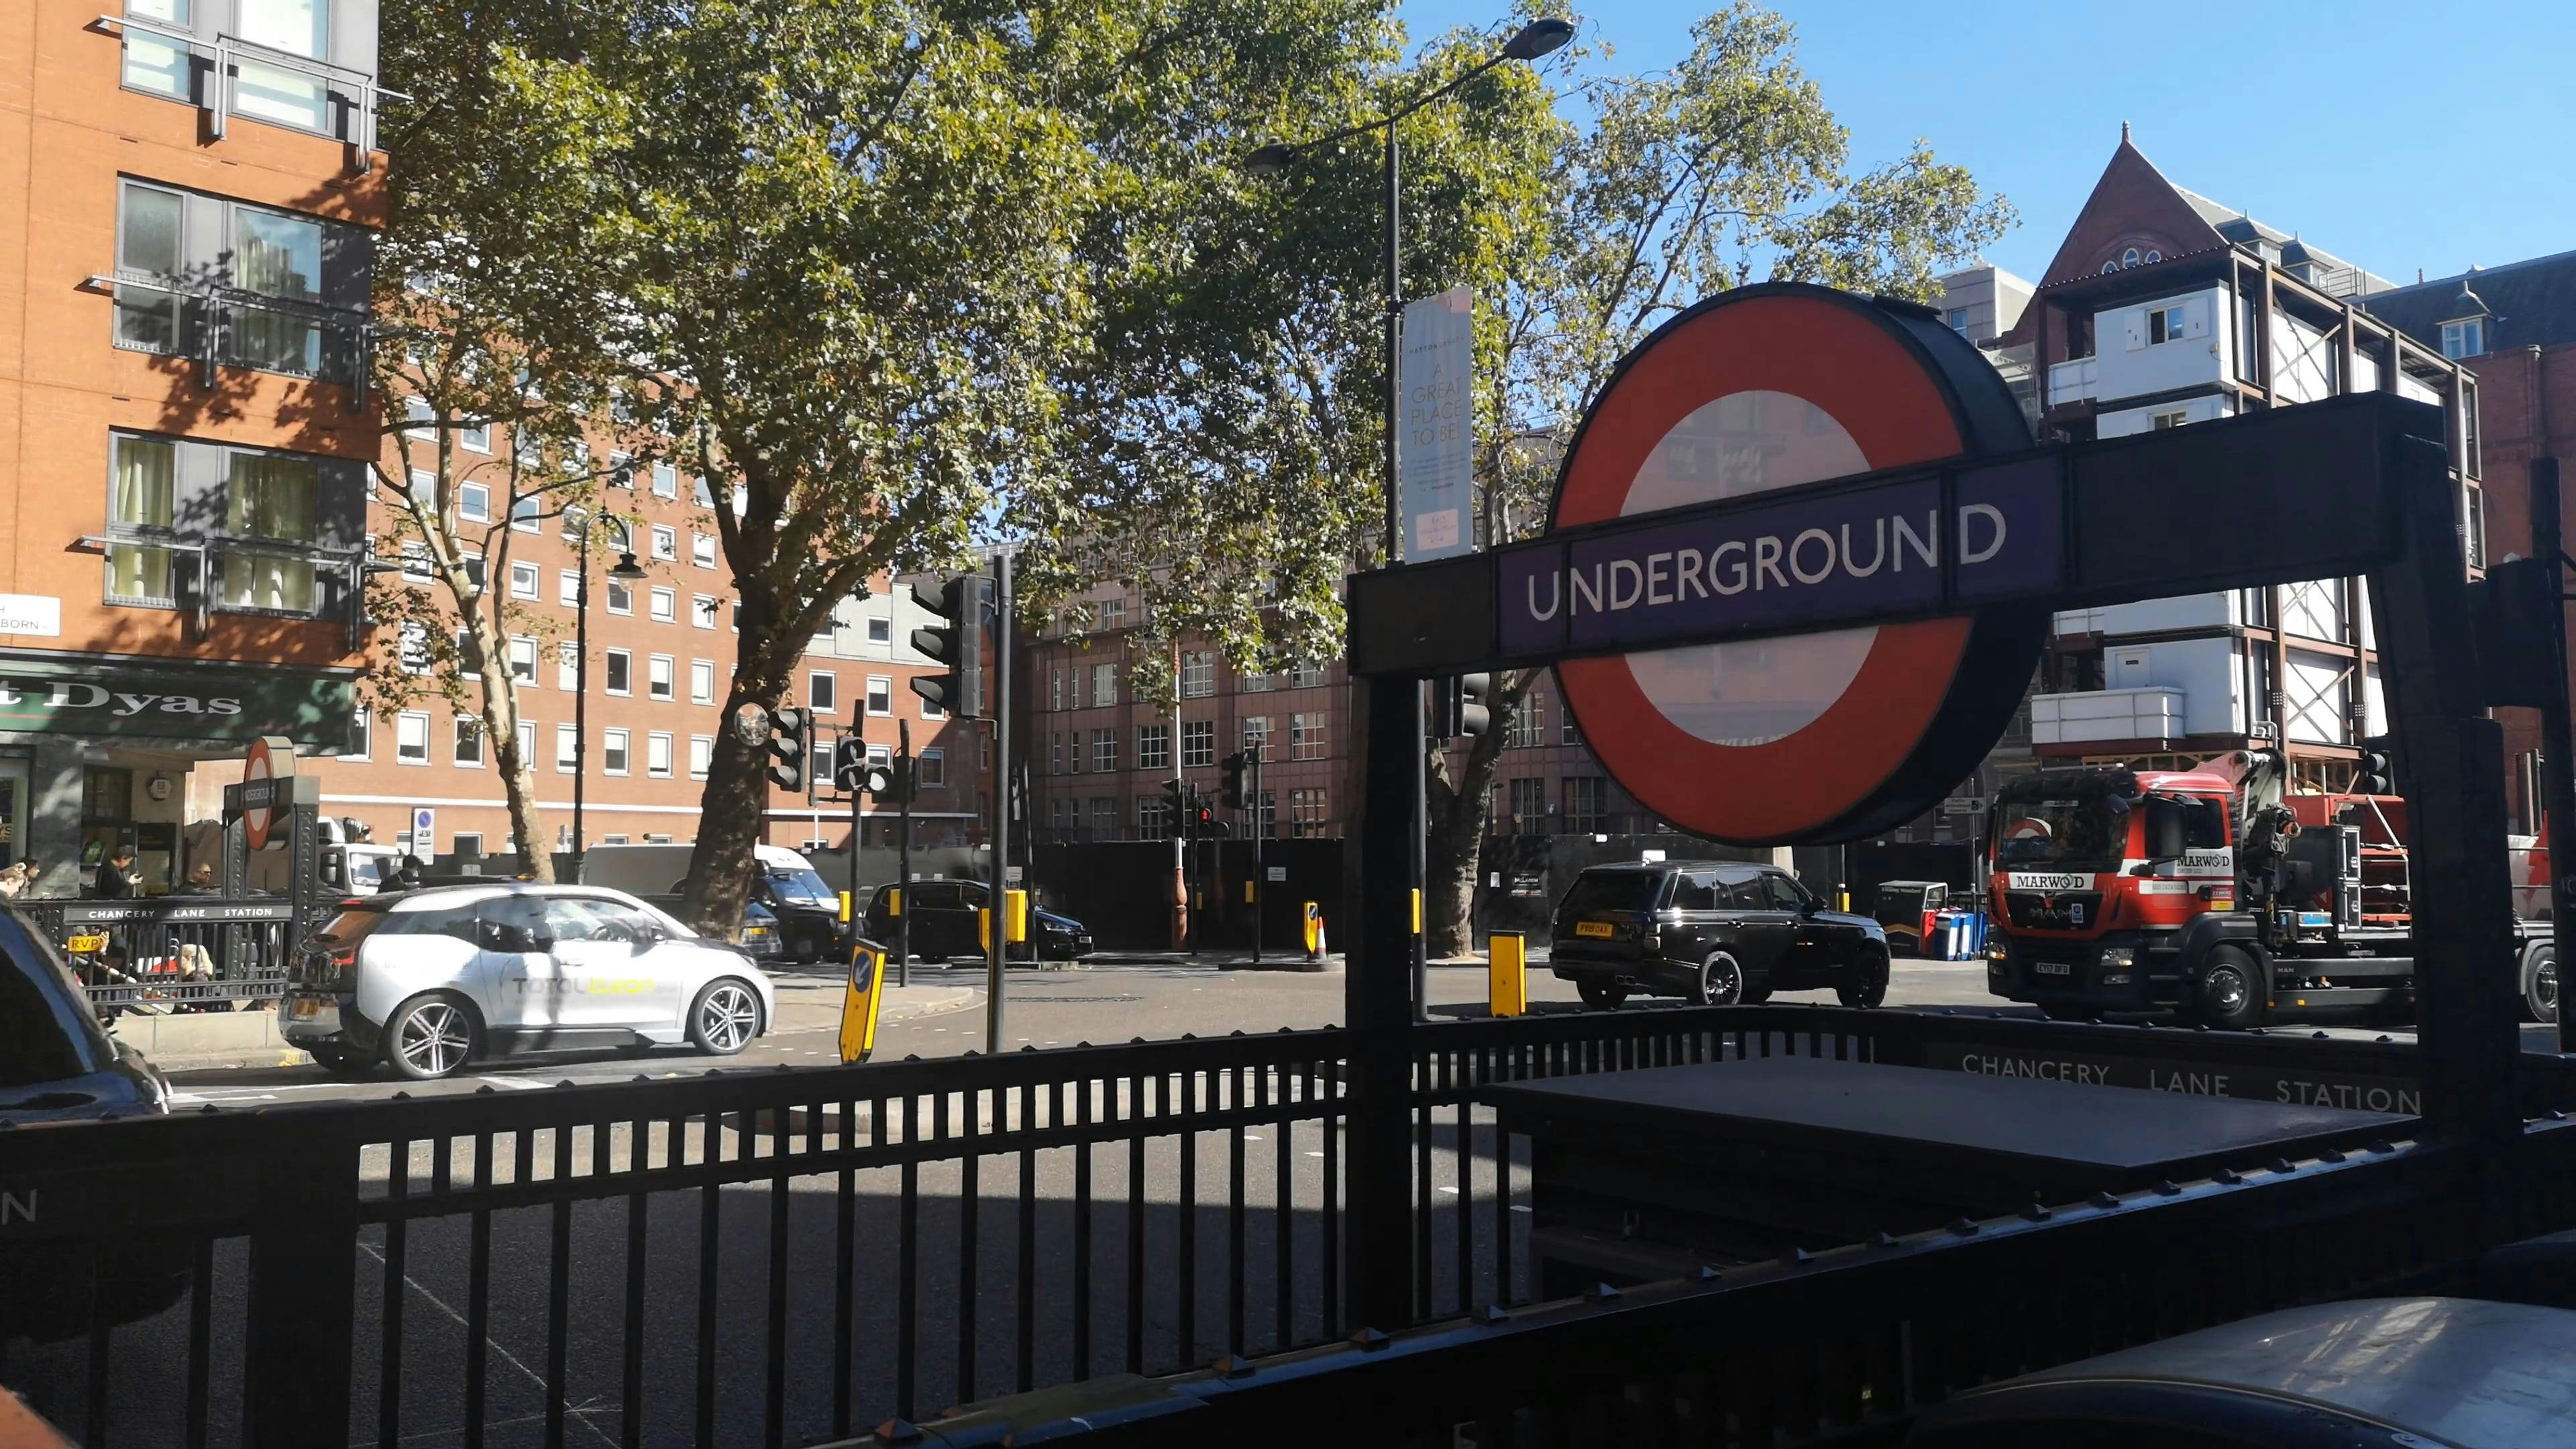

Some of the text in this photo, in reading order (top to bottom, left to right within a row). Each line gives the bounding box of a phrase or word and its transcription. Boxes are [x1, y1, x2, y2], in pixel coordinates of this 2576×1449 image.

[1432, 364, 1444, 378] A
[1411, 377, 1462, 404] GREAT
[1411, 400, 1461, 426] PLACE
[1411, 421, 1460, 446] TO BE!
[1528, 503, 2006, 621] UNDERGROUND
[43, 681, 241, 716] Dyas
[88, 908, 273, 919] CHANCERY LANE STATION
[70, 939, 99, 949] RVP
[1962, 1054, 2421, 1116] CHANCERY LANE STATION
[1, 1189, 38, 1225] N
